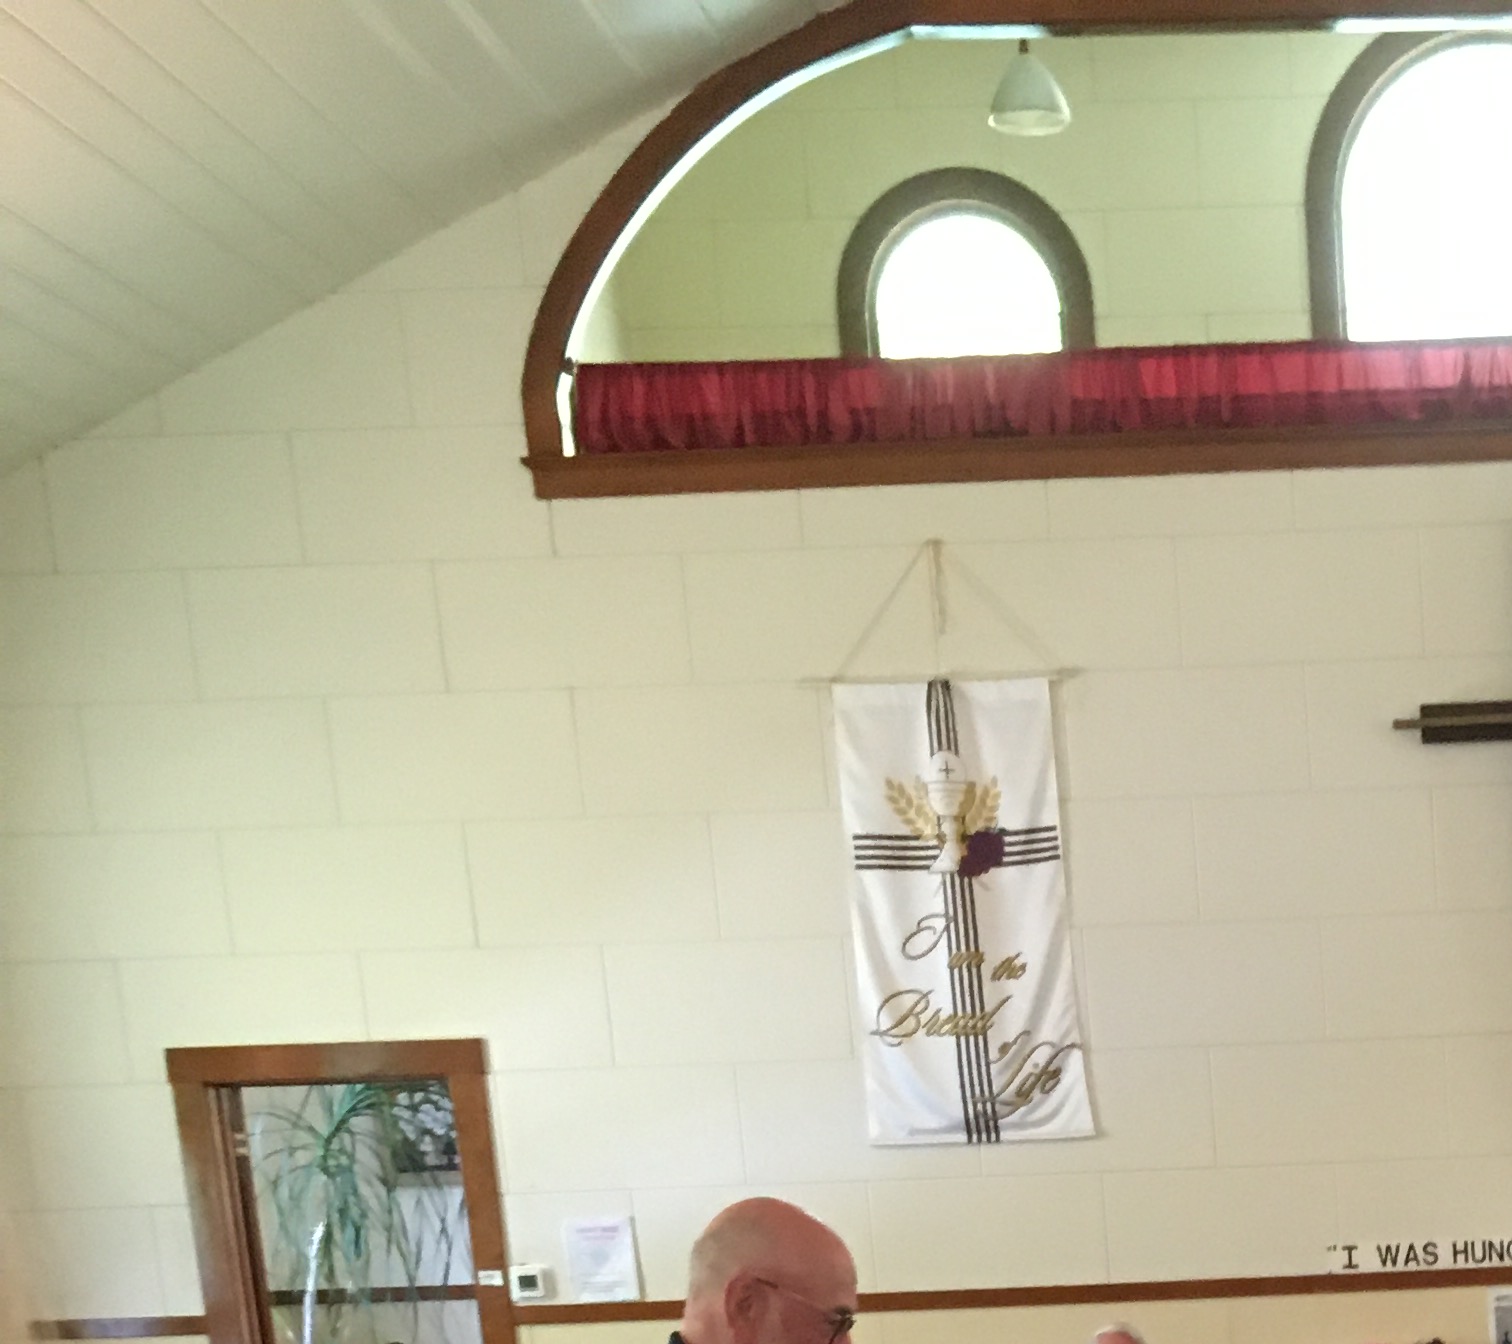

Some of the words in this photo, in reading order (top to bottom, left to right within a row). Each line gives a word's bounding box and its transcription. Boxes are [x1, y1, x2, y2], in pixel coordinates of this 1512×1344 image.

[990, 951, 1028, 983] the
[869, 988, 1013, 1048] Bread
[989, 1029, 1032, 1064] of
[972, 1040, 1083, 1122] Life
[1376, 1241, 1439, 1268] WAS
